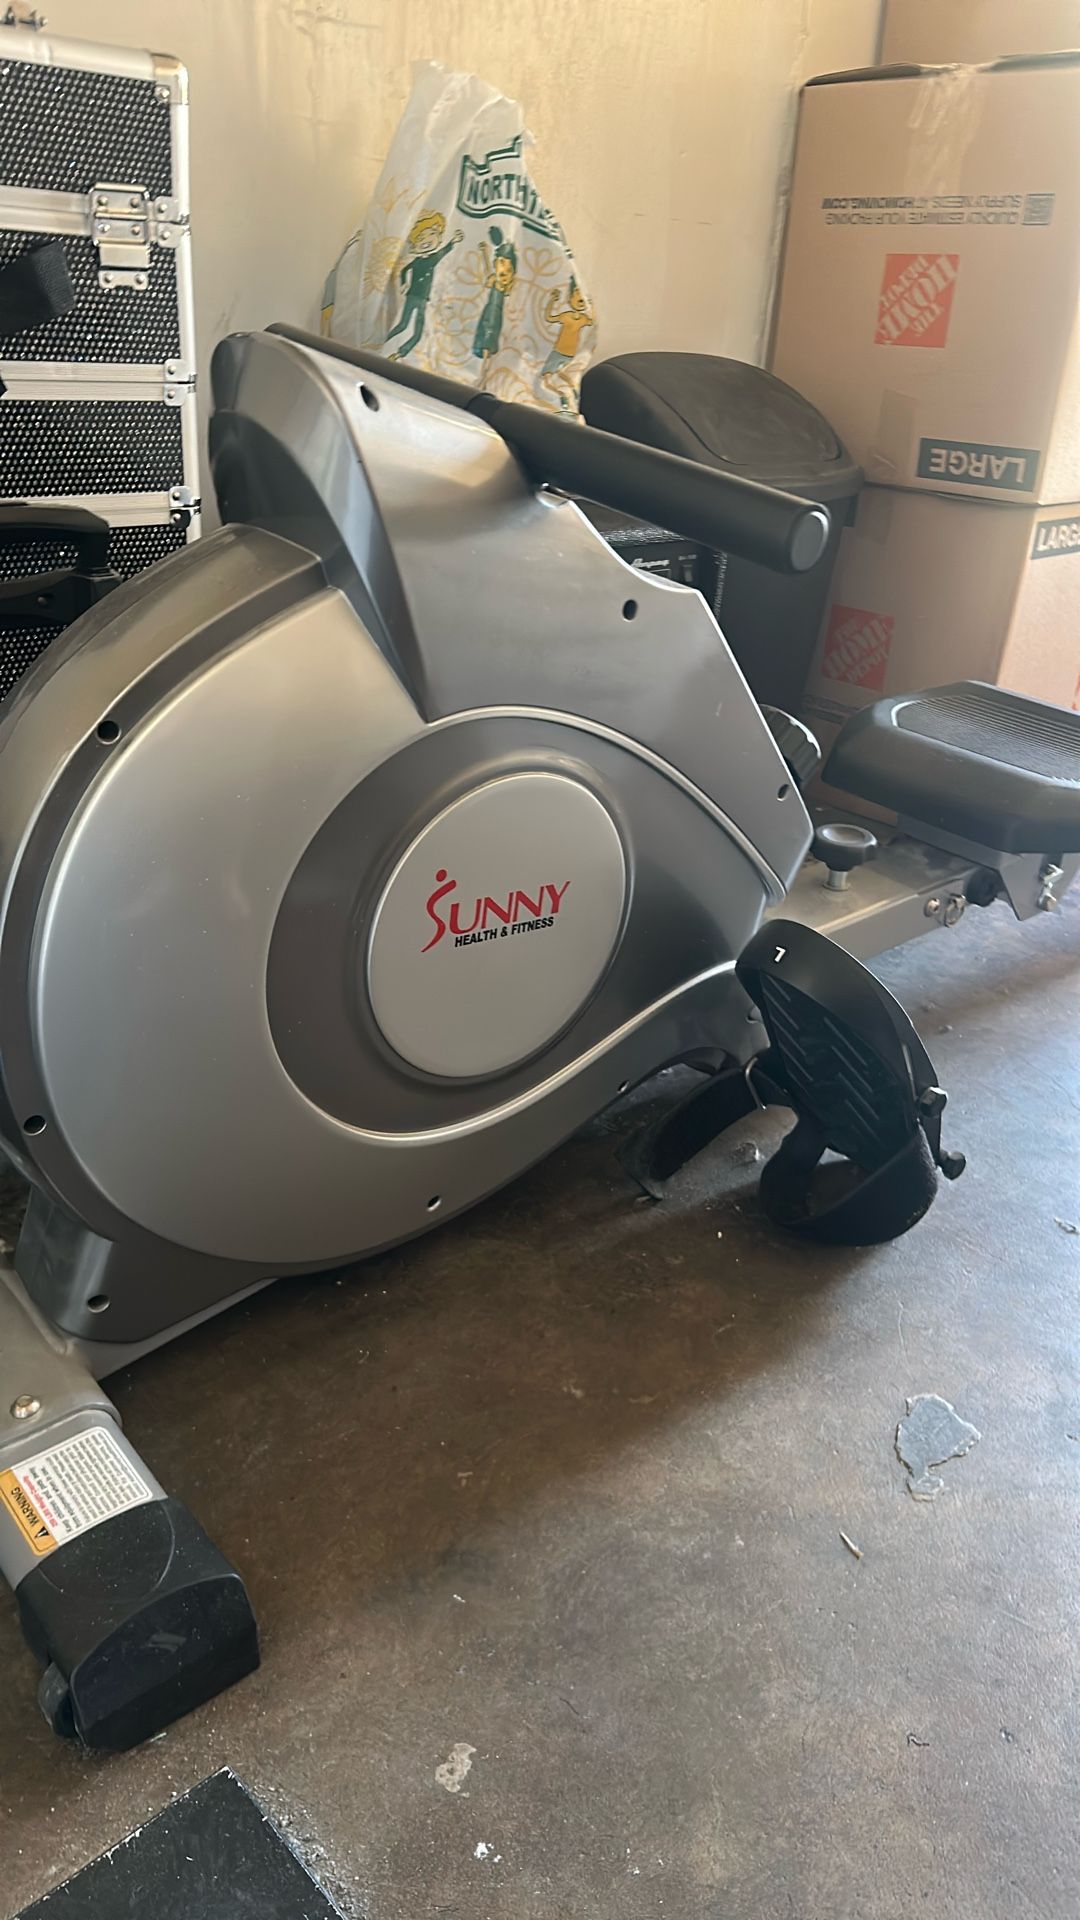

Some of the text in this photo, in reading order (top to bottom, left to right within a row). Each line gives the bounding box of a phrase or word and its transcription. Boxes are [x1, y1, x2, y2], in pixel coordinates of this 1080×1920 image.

[876, 256, 956, 343] HOME
[929, 447, 1026, 484] LARGE
[421, 869, 571, 953] SUNNY
[454, 916, 554, 948] HEALTH & FITNESS
[11, 1487, 39, 1527] WARNING
